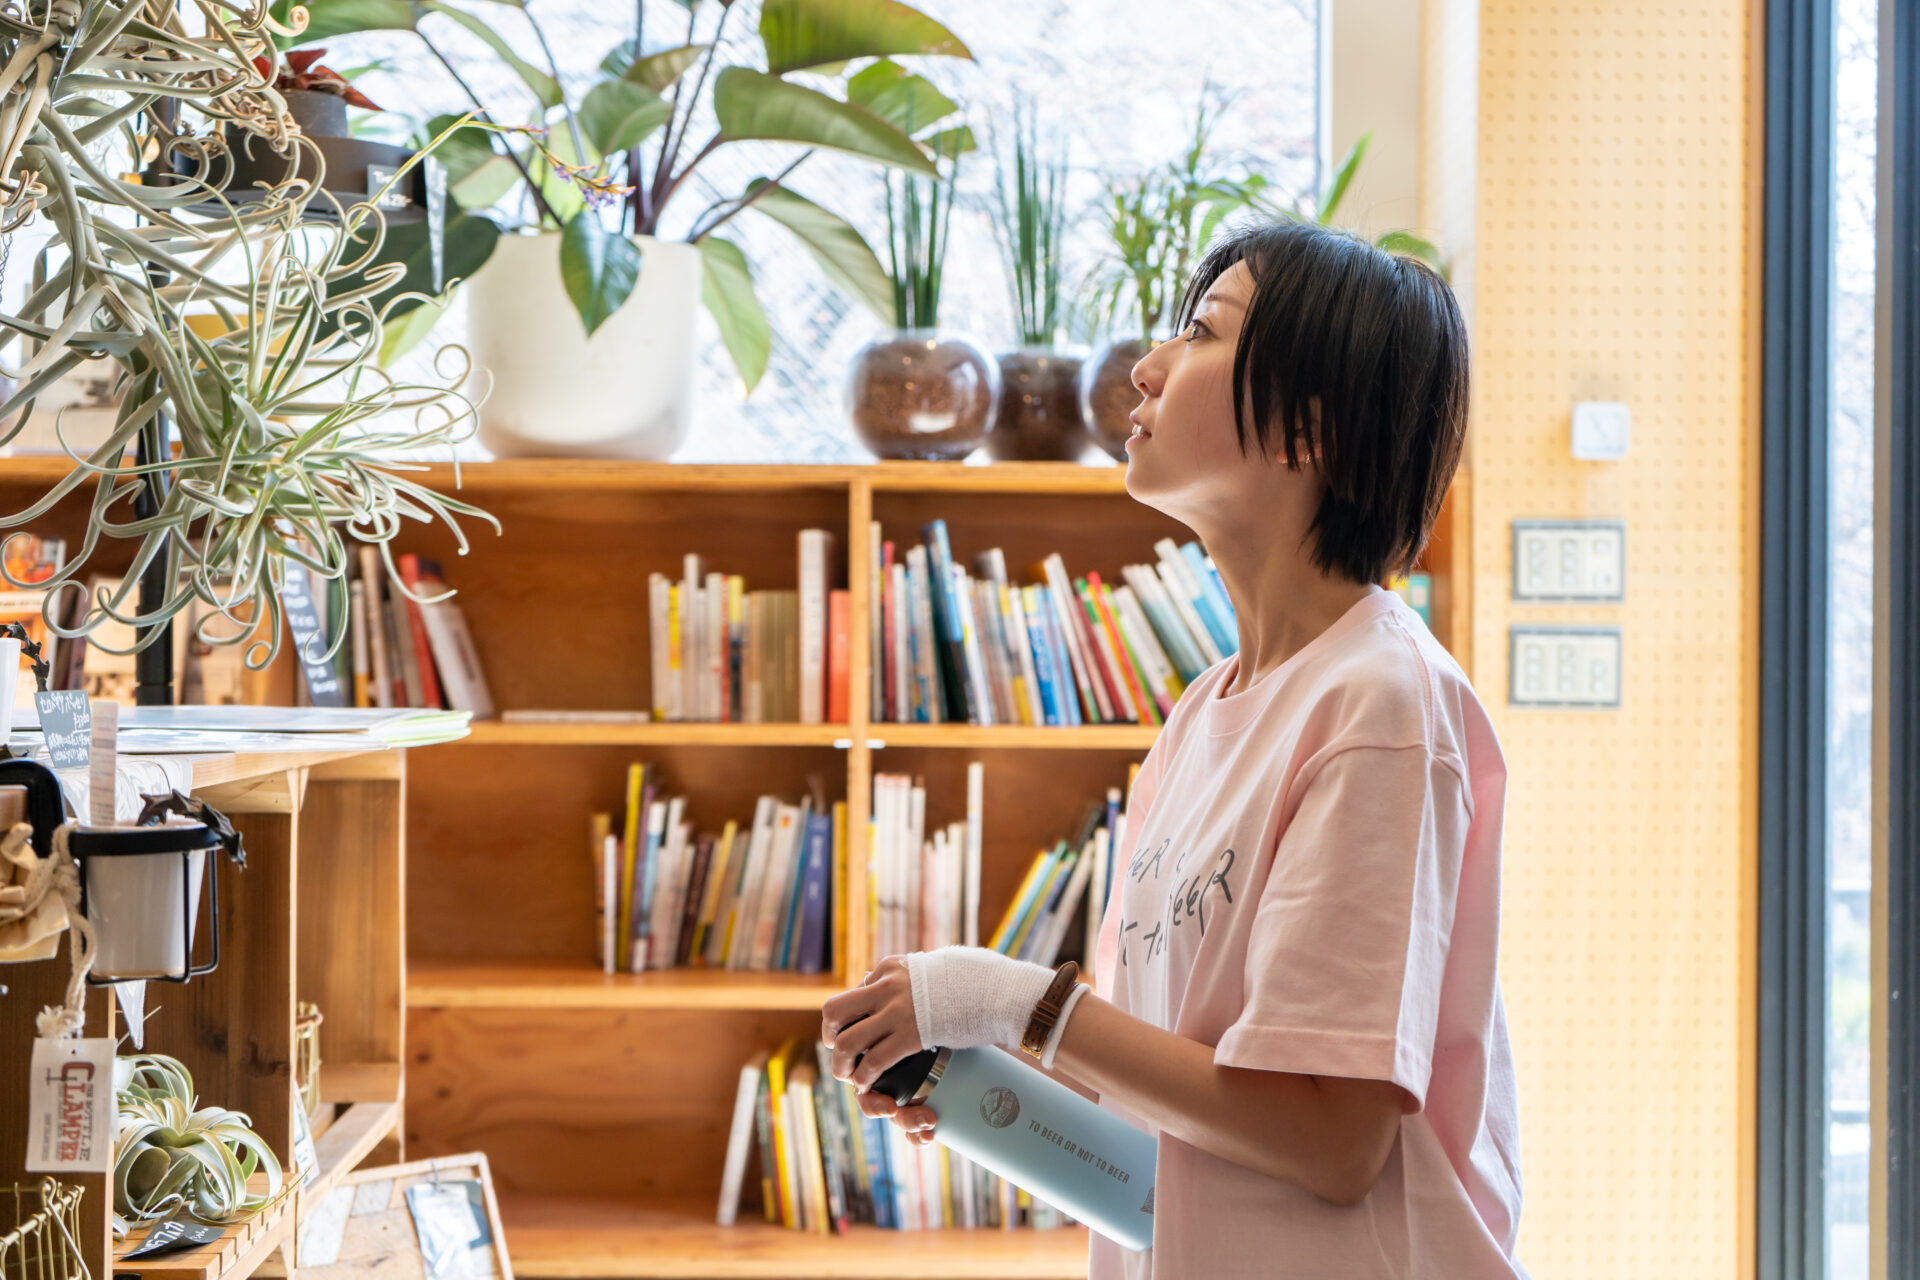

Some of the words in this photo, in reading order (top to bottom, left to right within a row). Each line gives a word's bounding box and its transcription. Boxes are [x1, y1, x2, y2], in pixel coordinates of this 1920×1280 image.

[60, 1061, 95, 1162] CLAMPER
[79, 1100, 94, 1162] BOTTLE
[1028, 1119, 1041, 1133] TO
[1041, 1127, 1064, 1146] BEER
[1063, 1140, 1077, 1154] OR
[1077, 1147, 1096, 1164] NOT
[1095, 1157, 1107, 1171] TO
[1107, 1164, 1130, 1184] BEER
